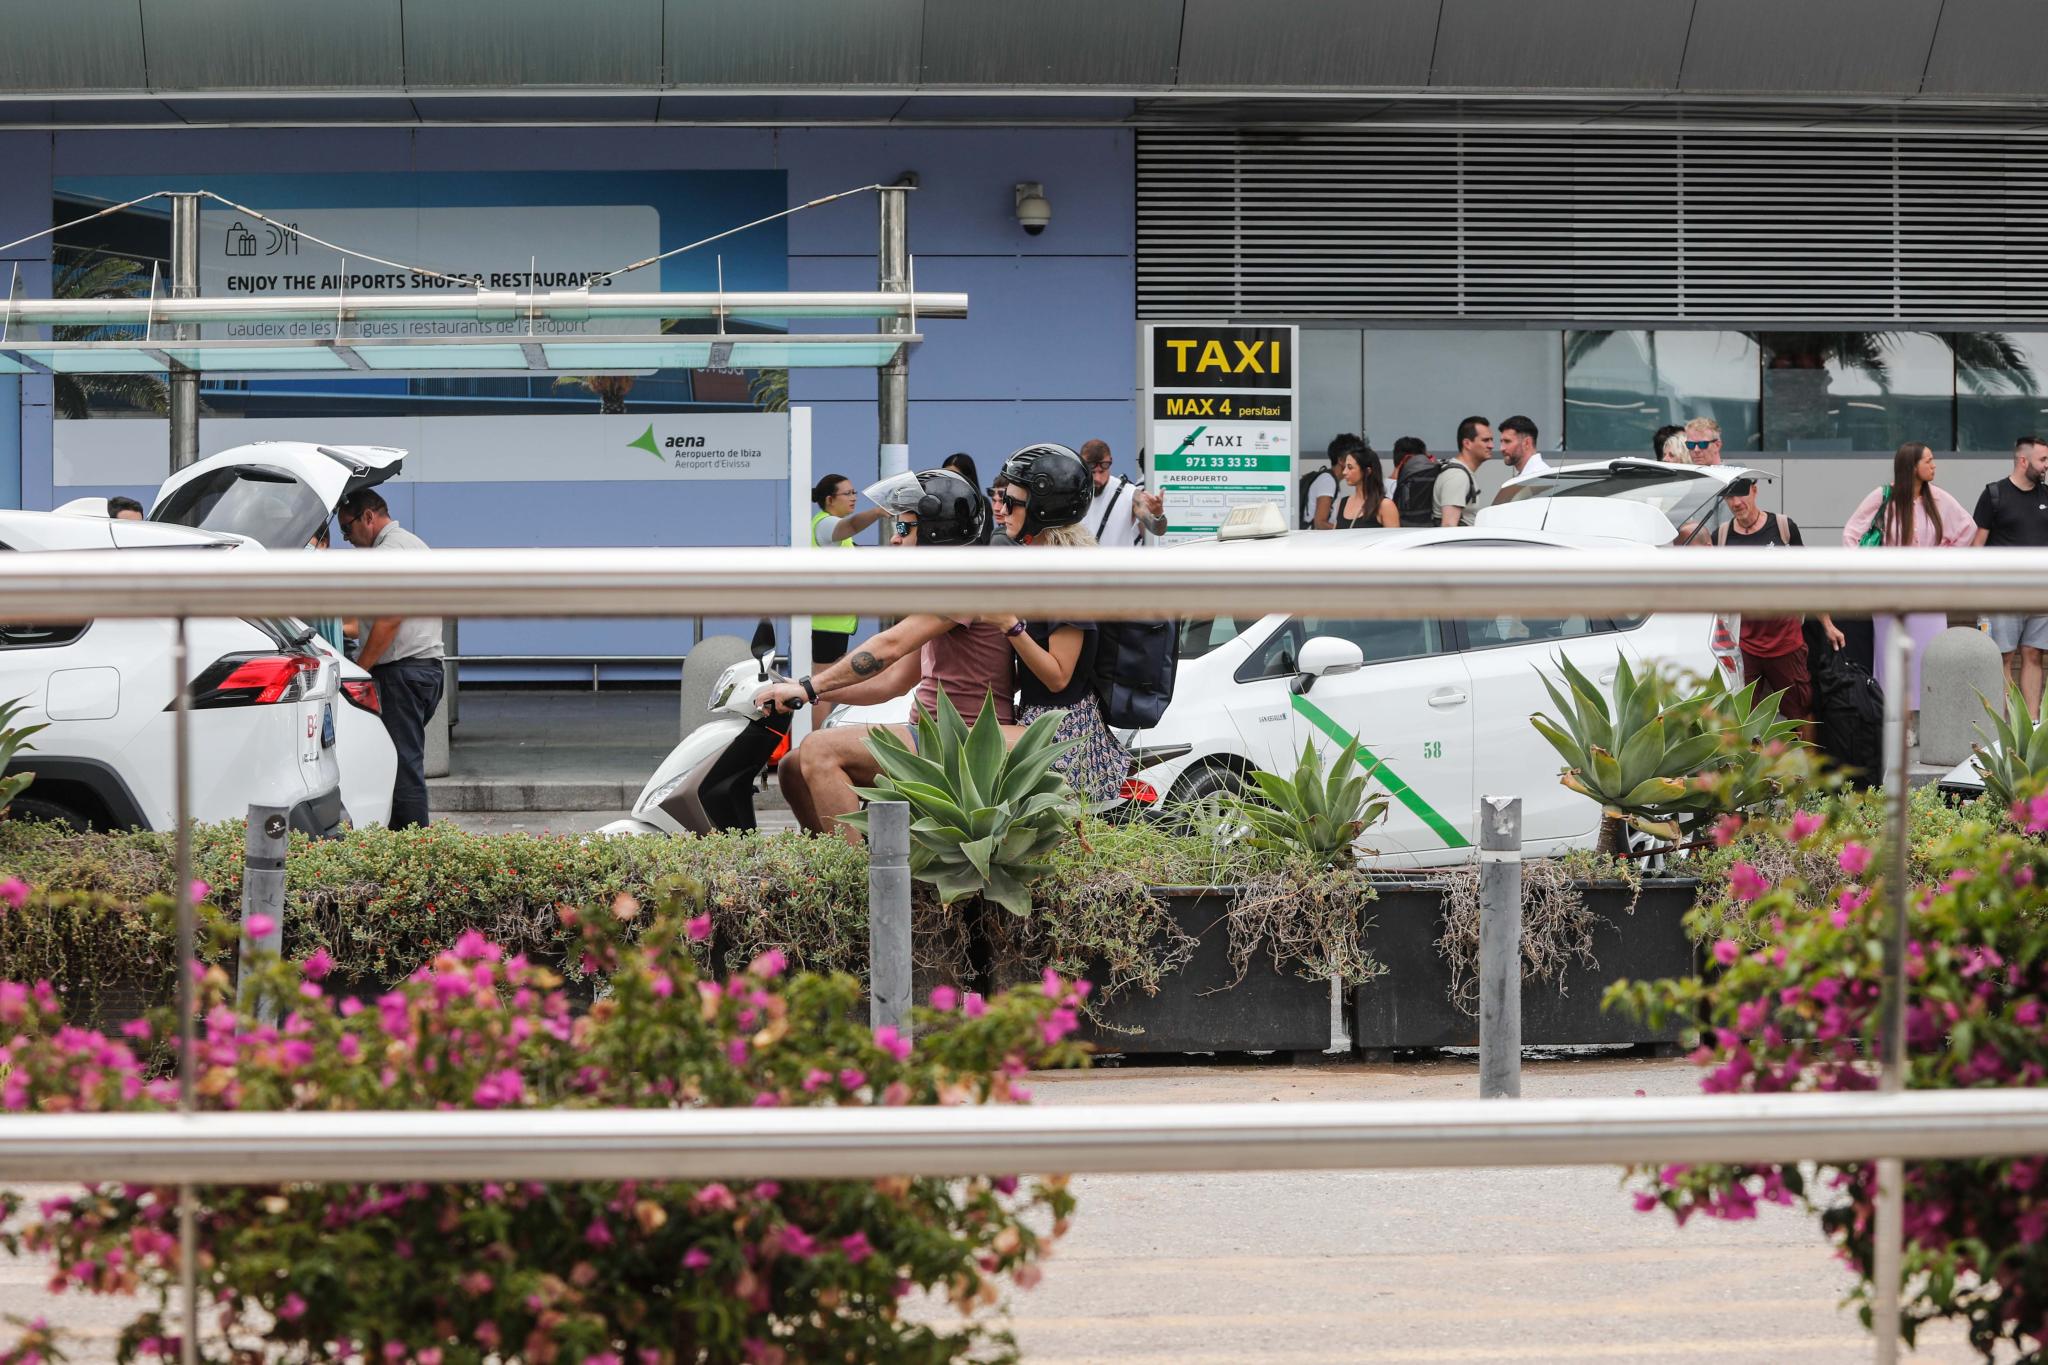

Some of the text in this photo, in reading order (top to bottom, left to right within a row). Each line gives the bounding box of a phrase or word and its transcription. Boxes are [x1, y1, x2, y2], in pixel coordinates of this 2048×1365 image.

[227, 276, 278, 293] ENJOY
[283, 275, 316, 290] THE
[321, 274, 406, 290] AIRPORTS
[411, 273, 467, 289] SHOPS
[289, 322, 307, 336] de
[311, 321, 331, 336] les
[409, 320, 492, 335] restaurants
[1166, 339, 1280, 374] TAXI
[1166, 398, 1281, 418] MAX 4 pers/taxi
[665, 436, 705, 448] aena
[1206, 435, 1243, 447] TAXI
[675, 449, 762, 460] Aeropuerto de Ibiza
[675, 459, 750, 470] Aeroport d'Eivissa
[1185, 457, 1258, 468] 971 33 33 33
[1424, 741, 1442, 759] 58
